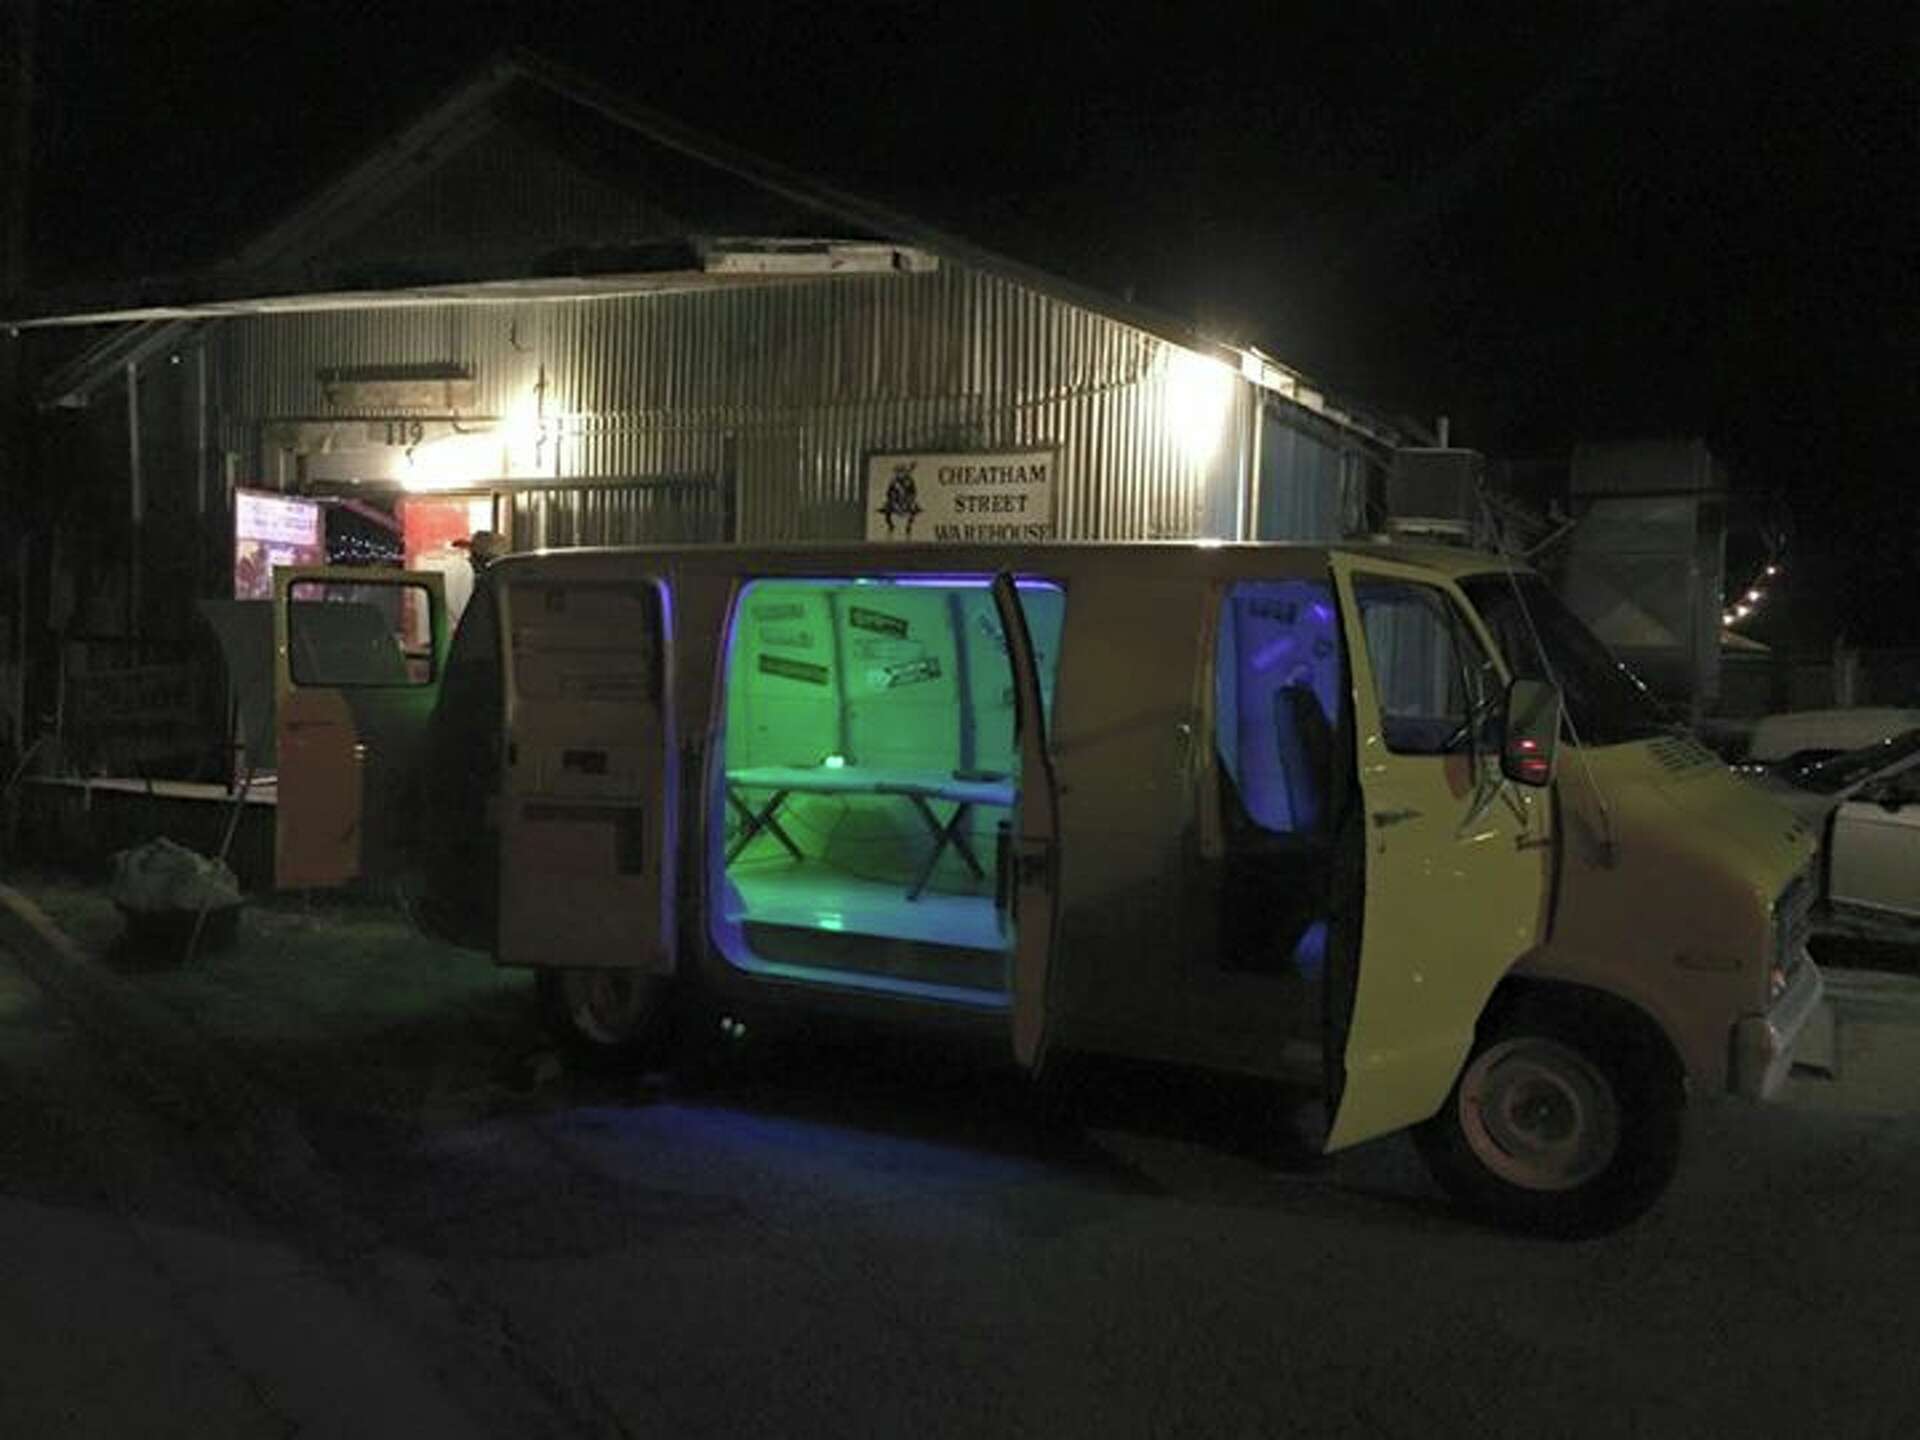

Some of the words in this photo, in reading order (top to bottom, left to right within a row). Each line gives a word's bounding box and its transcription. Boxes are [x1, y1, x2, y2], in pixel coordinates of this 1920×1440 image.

[386, 421, 424, 446] 119
[938, 465, 1046, 485] CHEATHAM
[954, 494, 1027, 513] STREET
[935, 523, 1051, 541] WAREHOUSE
